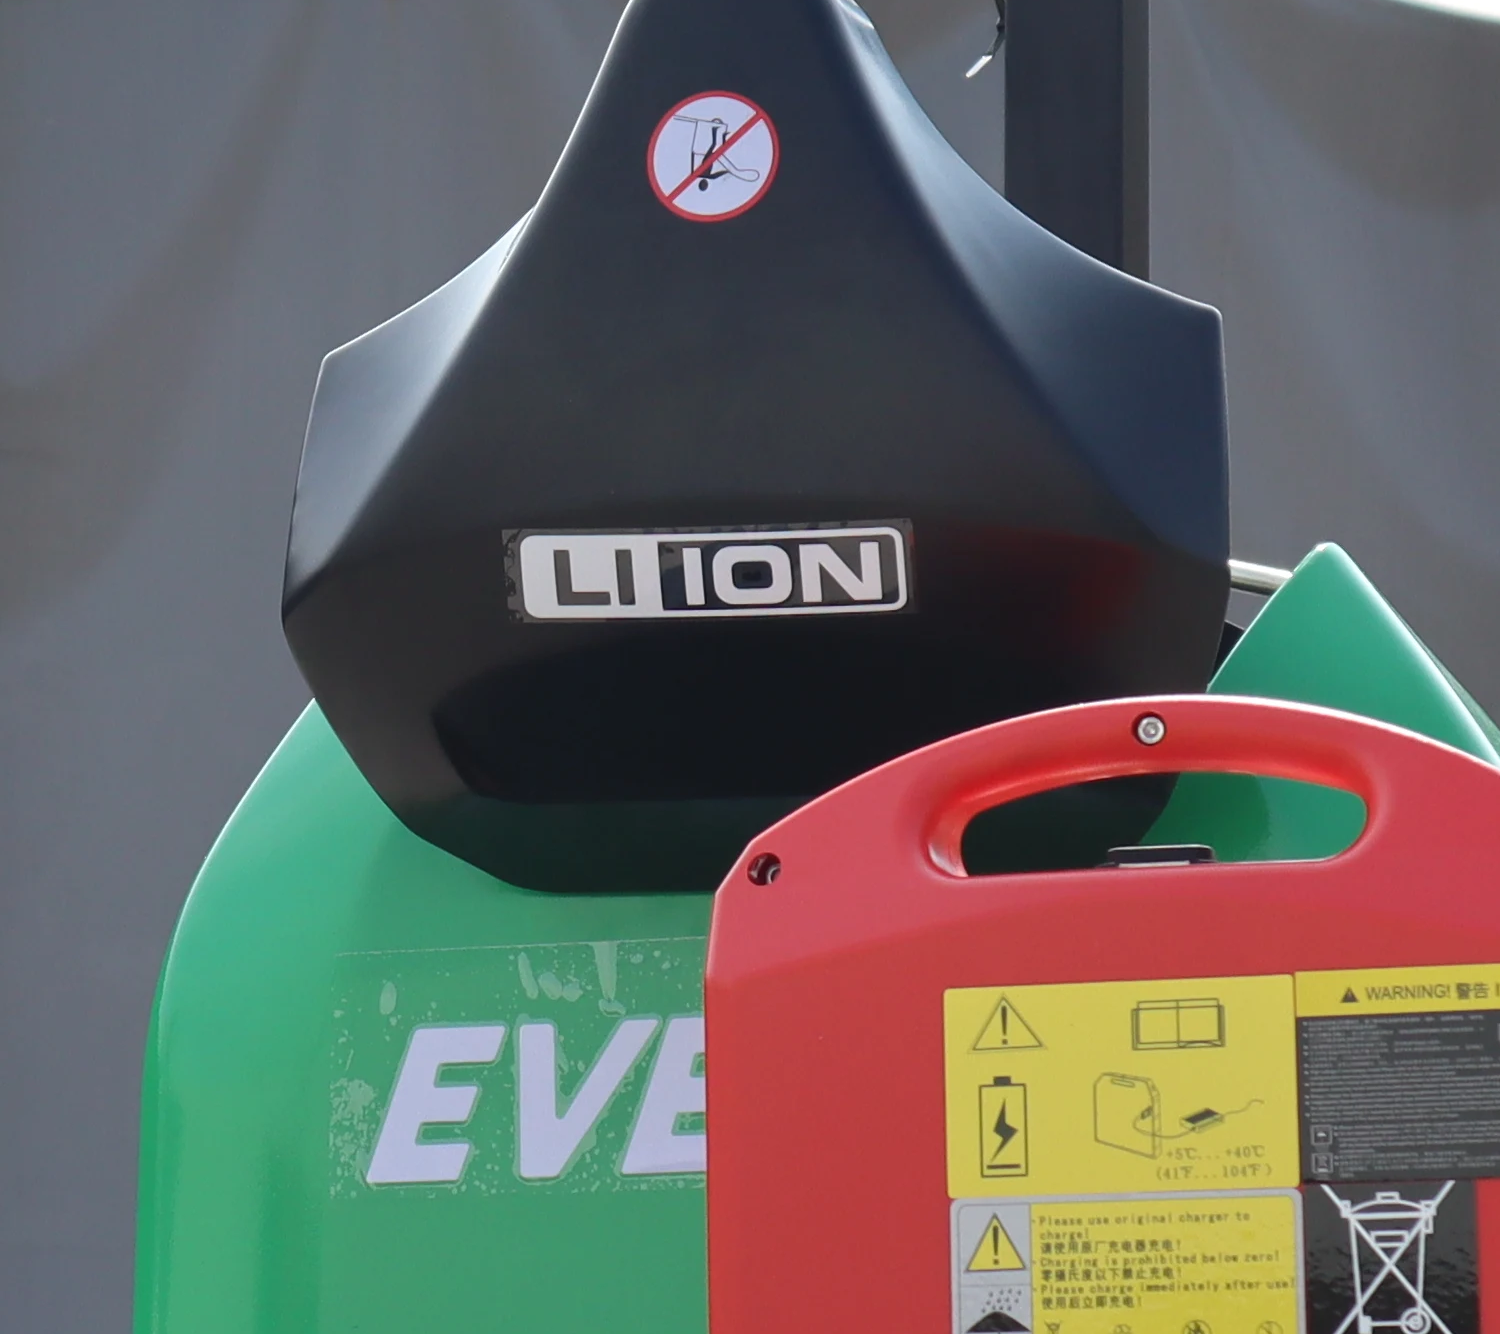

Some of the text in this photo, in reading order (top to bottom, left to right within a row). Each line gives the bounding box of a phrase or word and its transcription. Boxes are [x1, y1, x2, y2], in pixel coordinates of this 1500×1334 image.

[552, 540, 883, 607] LI ION
[1364, 984, 1451, 1001] WARNING!
[1038, 1211, 1251, 1226] Please use original charger to
[1040, 1255, 1099, 1268] Charging
[1105, 1256, 1118, 1266] is
[1123, 1253, 1198, 1267] prohibited
[1201, 1252, 1239, 1264] below
[1040, 1284, 1085, 1295] Please
[1089, 1283, 1134, 1295] charge
[1224, 1278, 1260, 1291] after
